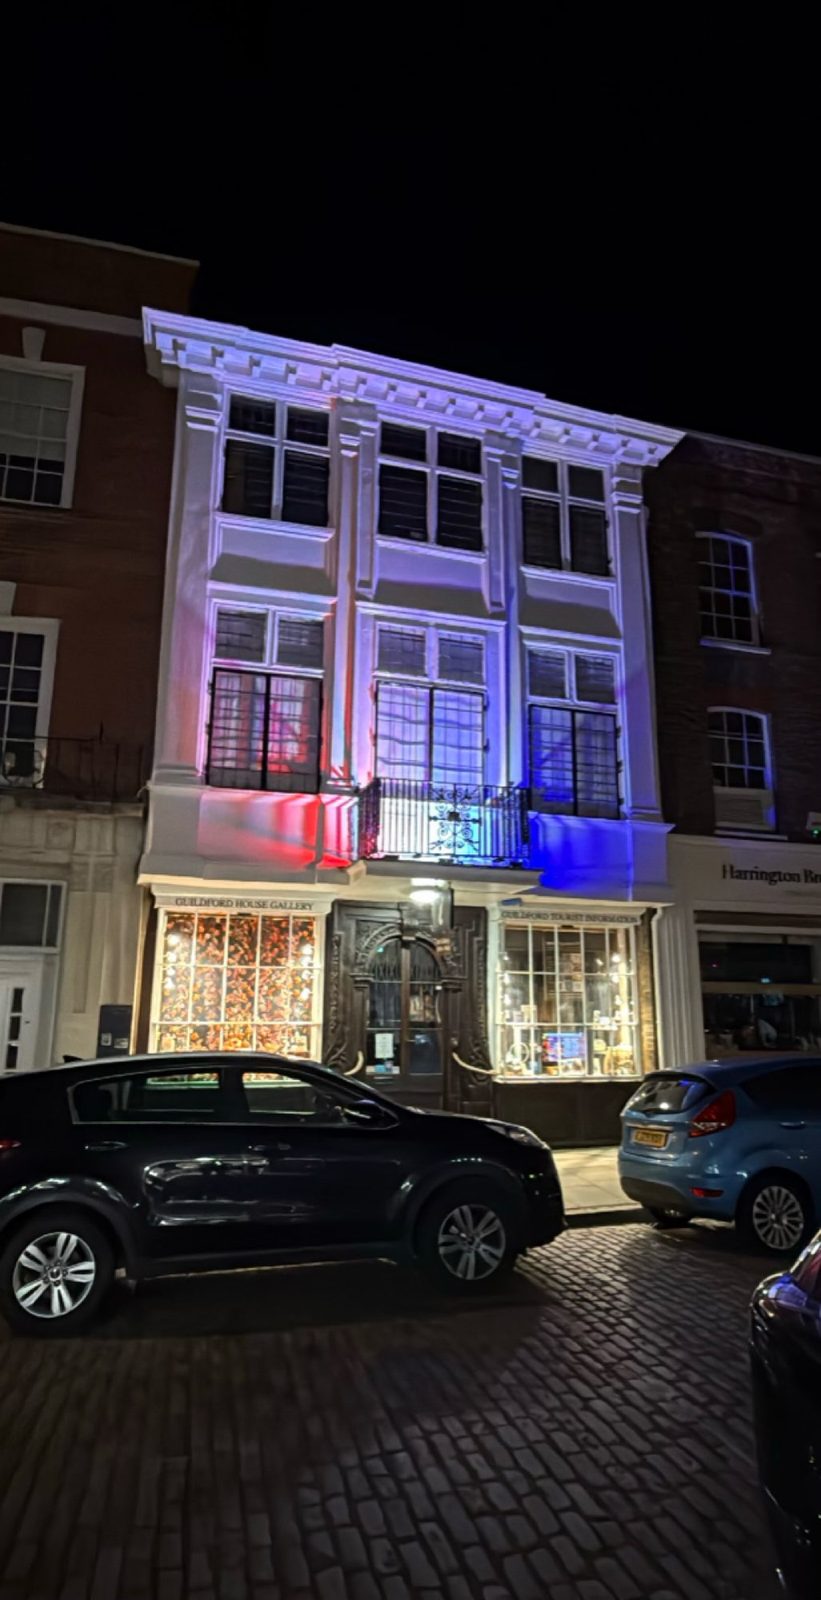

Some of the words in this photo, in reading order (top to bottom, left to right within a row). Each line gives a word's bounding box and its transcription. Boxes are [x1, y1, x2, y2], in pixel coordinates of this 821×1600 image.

[722, 864, 800, 885] Harrington
[176, 897, 233, 908] GUILDFORD
[235, 900, 267, 909] HOUSE
[270, 901, 314, 911] GALLERY
[501, 911, 549, 920] GUILDFORD
[551, 913, 583, 922] TOURIST
[585, 914, 638, 923] INFORMATION
